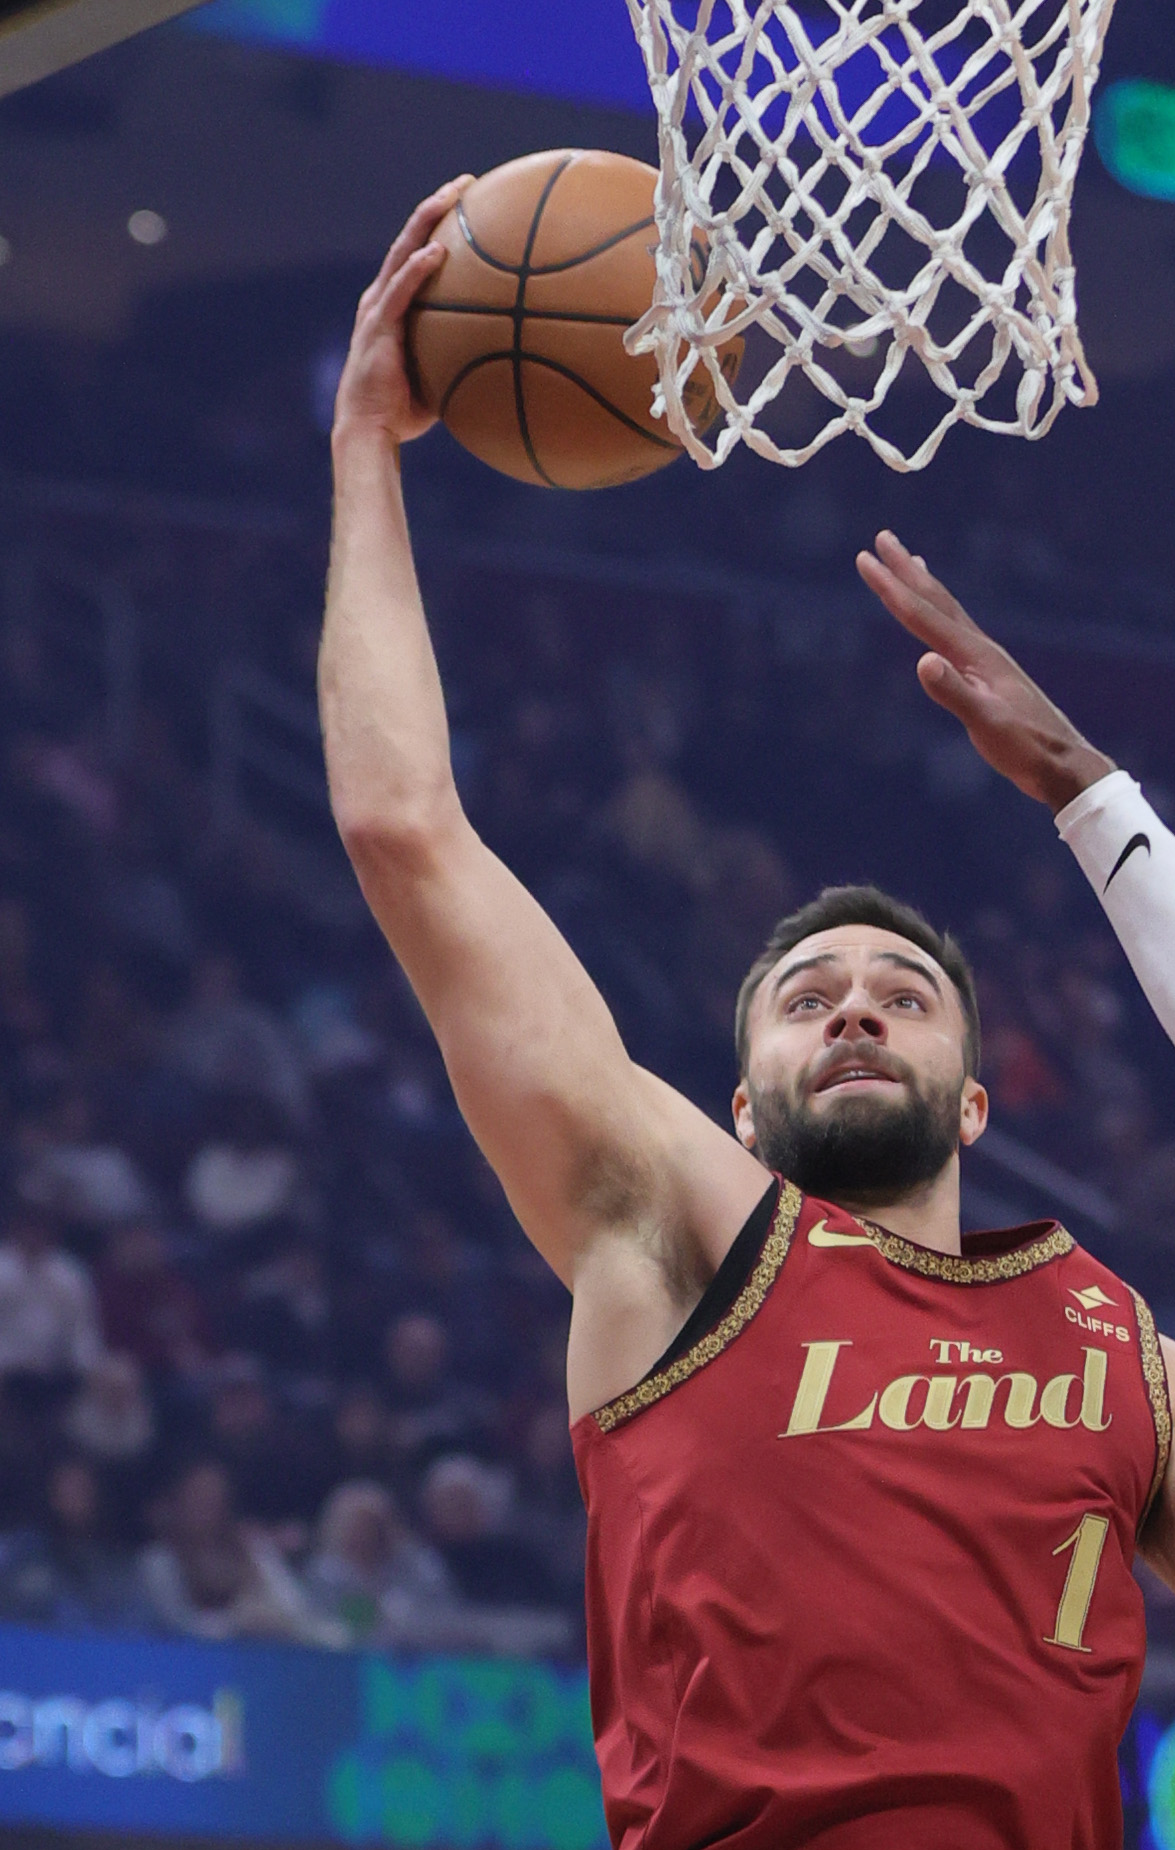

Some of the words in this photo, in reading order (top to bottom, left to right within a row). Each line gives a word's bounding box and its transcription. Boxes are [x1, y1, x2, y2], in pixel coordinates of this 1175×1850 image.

[929, 1338, 1004, 1365] The
[1064, 1306, 1131, 1343] CLIFFS
[777, 1338, 1113, 1439] Land
[1043, 1513, 1110, 1653] 1
